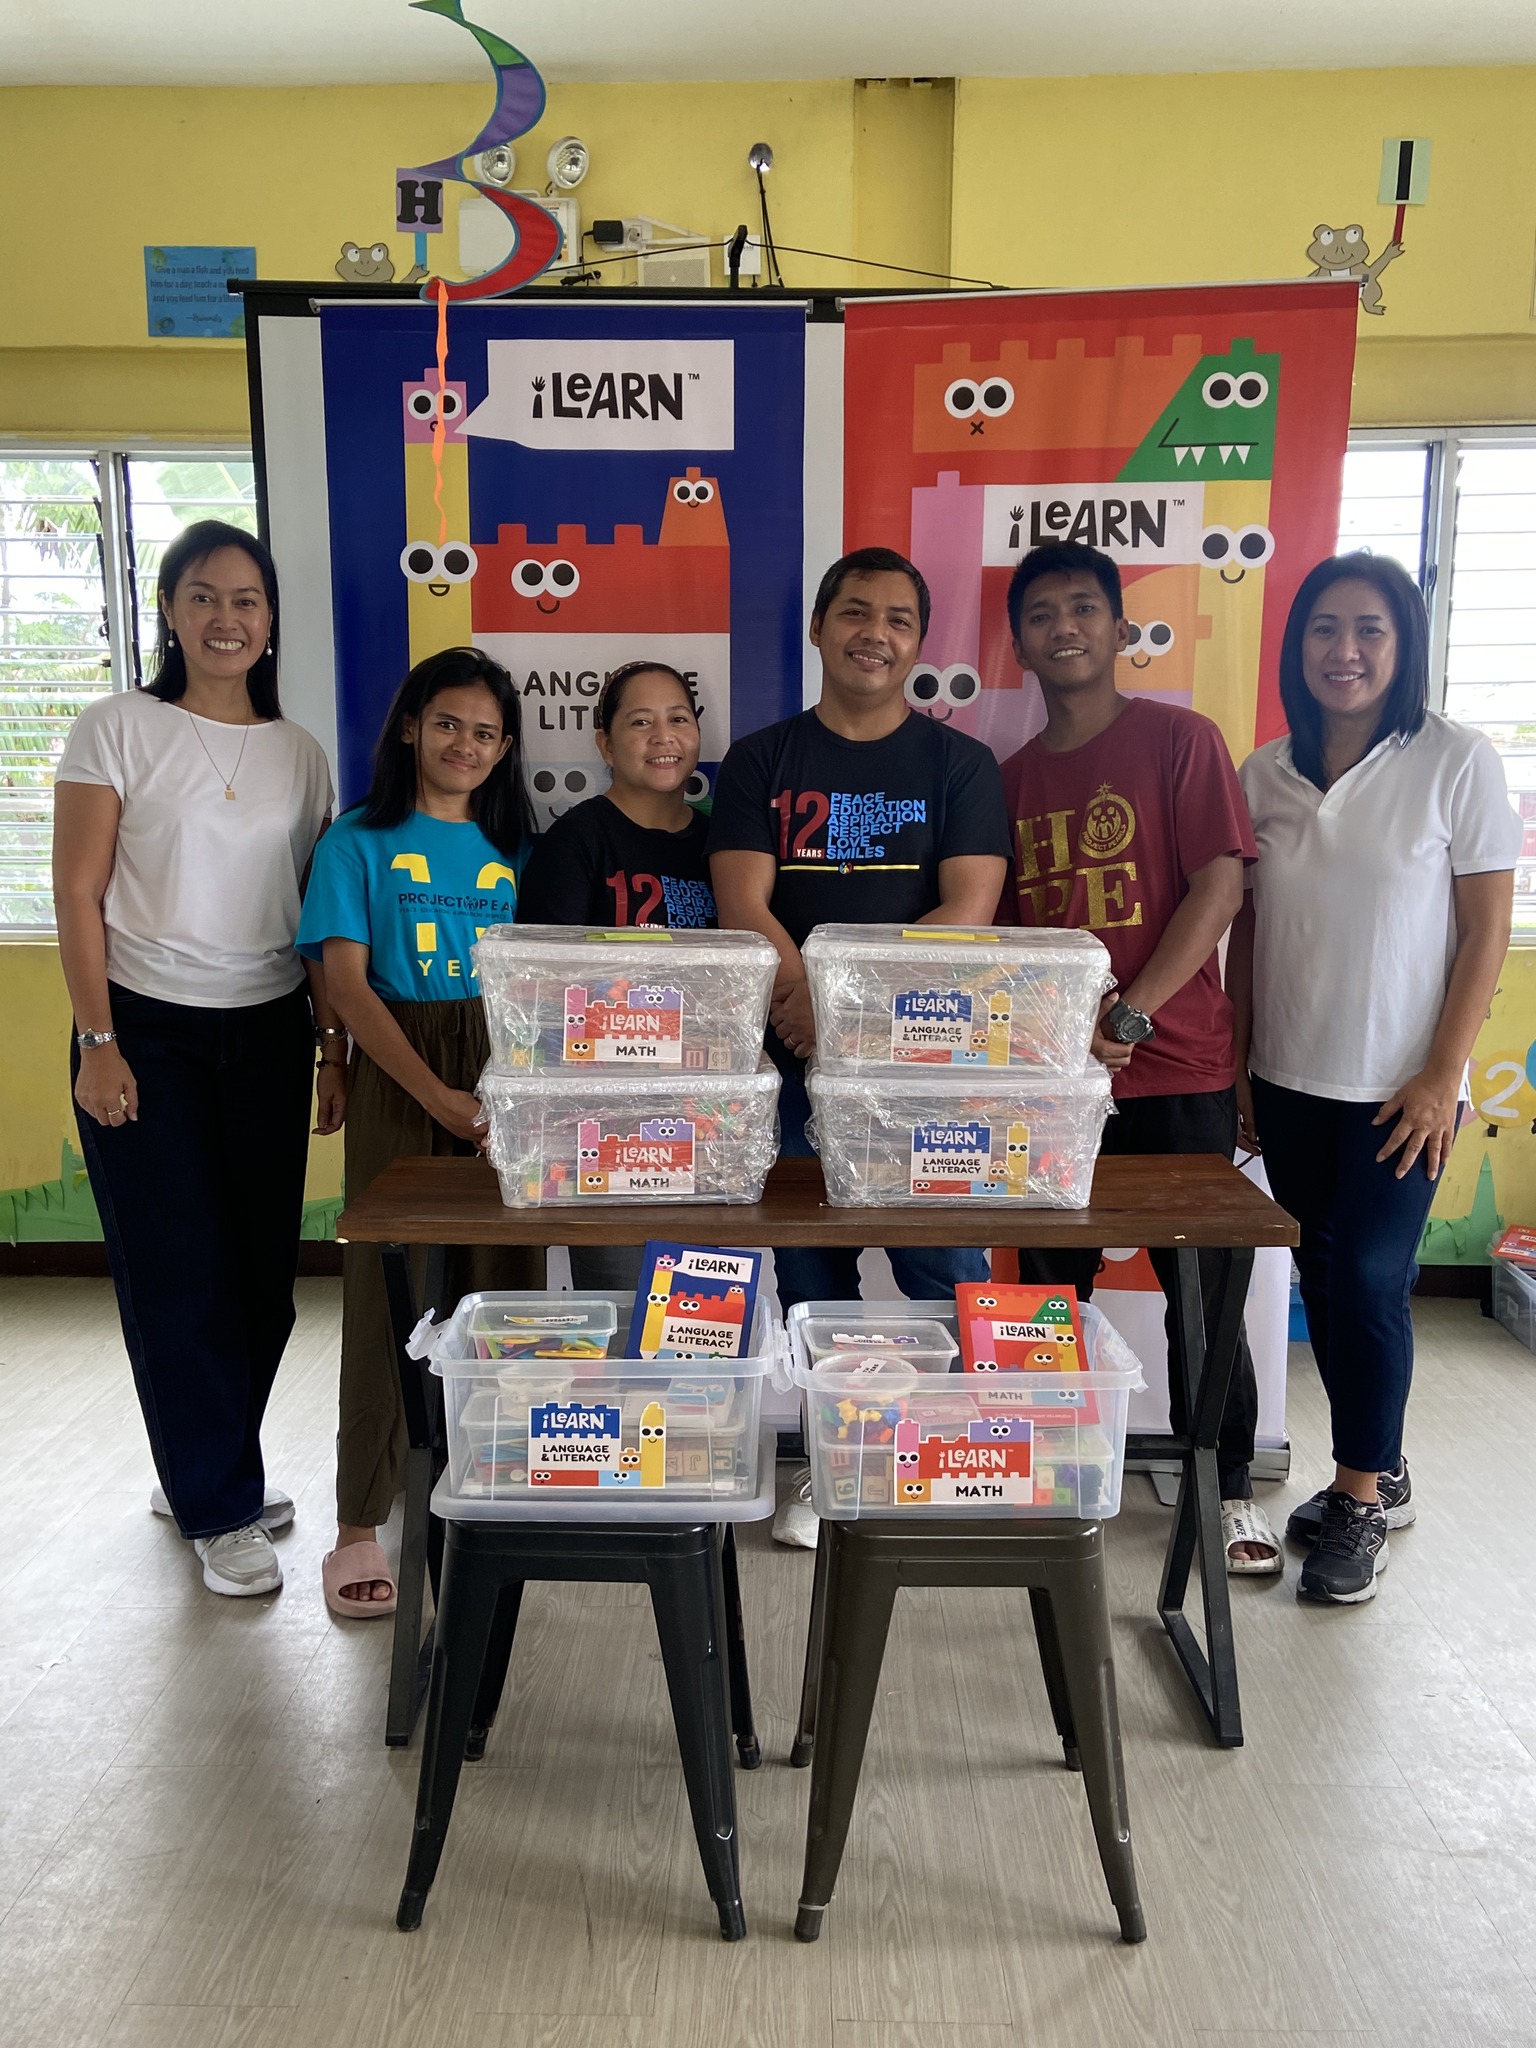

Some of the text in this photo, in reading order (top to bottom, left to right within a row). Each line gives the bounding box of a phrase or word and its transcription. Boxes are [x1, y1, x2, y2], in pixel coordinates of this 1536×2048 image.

[397, 180, 442, 224] H
[831, 791, 886, 805] PEACE
[829, 799, 926, 815] EDUCATION
[770, 789, 830, 860] 12
[827, 810, 927, 826] ASPIRATION
[828, 821, 904, 838] RESPECT
[827, 835, 871, 849] LOVE
[796, 848, 822, 858] YEARS
[826, 845, 885, 860] SMILES
[660, 875, 708, 890] PEACE
[606, 869, 663, 927] 12
[662, 883, 713, 899] EDUCA
[398, 892, 462, 908] PROJECT
[664, 894, 716, 908] ASPIRA
[667, 913, 708, 928] LOVE
[904, 1025, 962, 1035] LANGUAGE
[902, 1033, 963, 1043] & LITERACY
[616, 1046, 656, 1057] MATH
[1480, 1061, 1526, 1118] 2
[923, 1158, 980, 1166] LANGUAGE
[922, 1165, 981, 1174] & LITERACY
[629, 1178, 670, 1188] MATH
[670, 1325, 733, 1339] LANGUAGE
[666, 1334, 733, 1349] & LITERACY
[988, 1391, 1023, 1400] MATH
[542, 1444, 609, 1453] LANGUAGE
[541, 1453, 610, 1462] & LITERACY
[955, 1485, 1003, 1497] MATH
